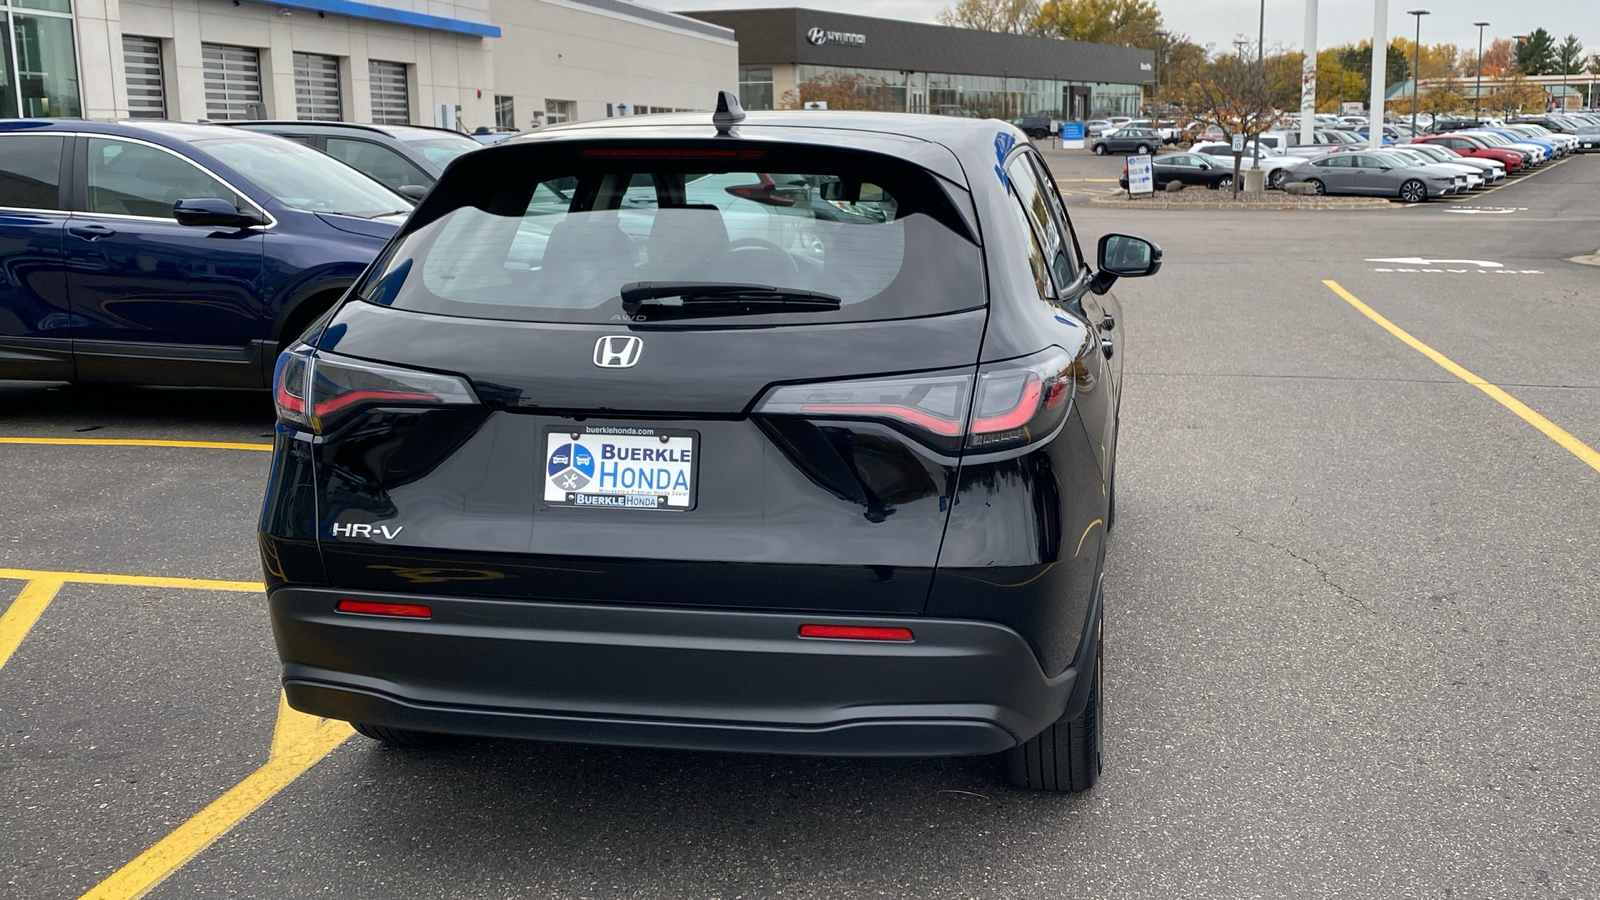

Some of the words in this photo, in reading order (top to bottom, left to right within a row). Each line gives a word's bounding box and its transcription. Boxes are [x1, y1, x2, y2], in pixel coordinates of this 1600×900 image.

[586, 426, 654, 435] buerklehonda.com
[601, 444, 690, 463] BUERKLE
[600, 461, 688, 490] HONDA
[577, 494, 625, 505] BUERKLE
[626, 495, 656, 506] HONDA
[332, 522, 403, 540] HR-V
